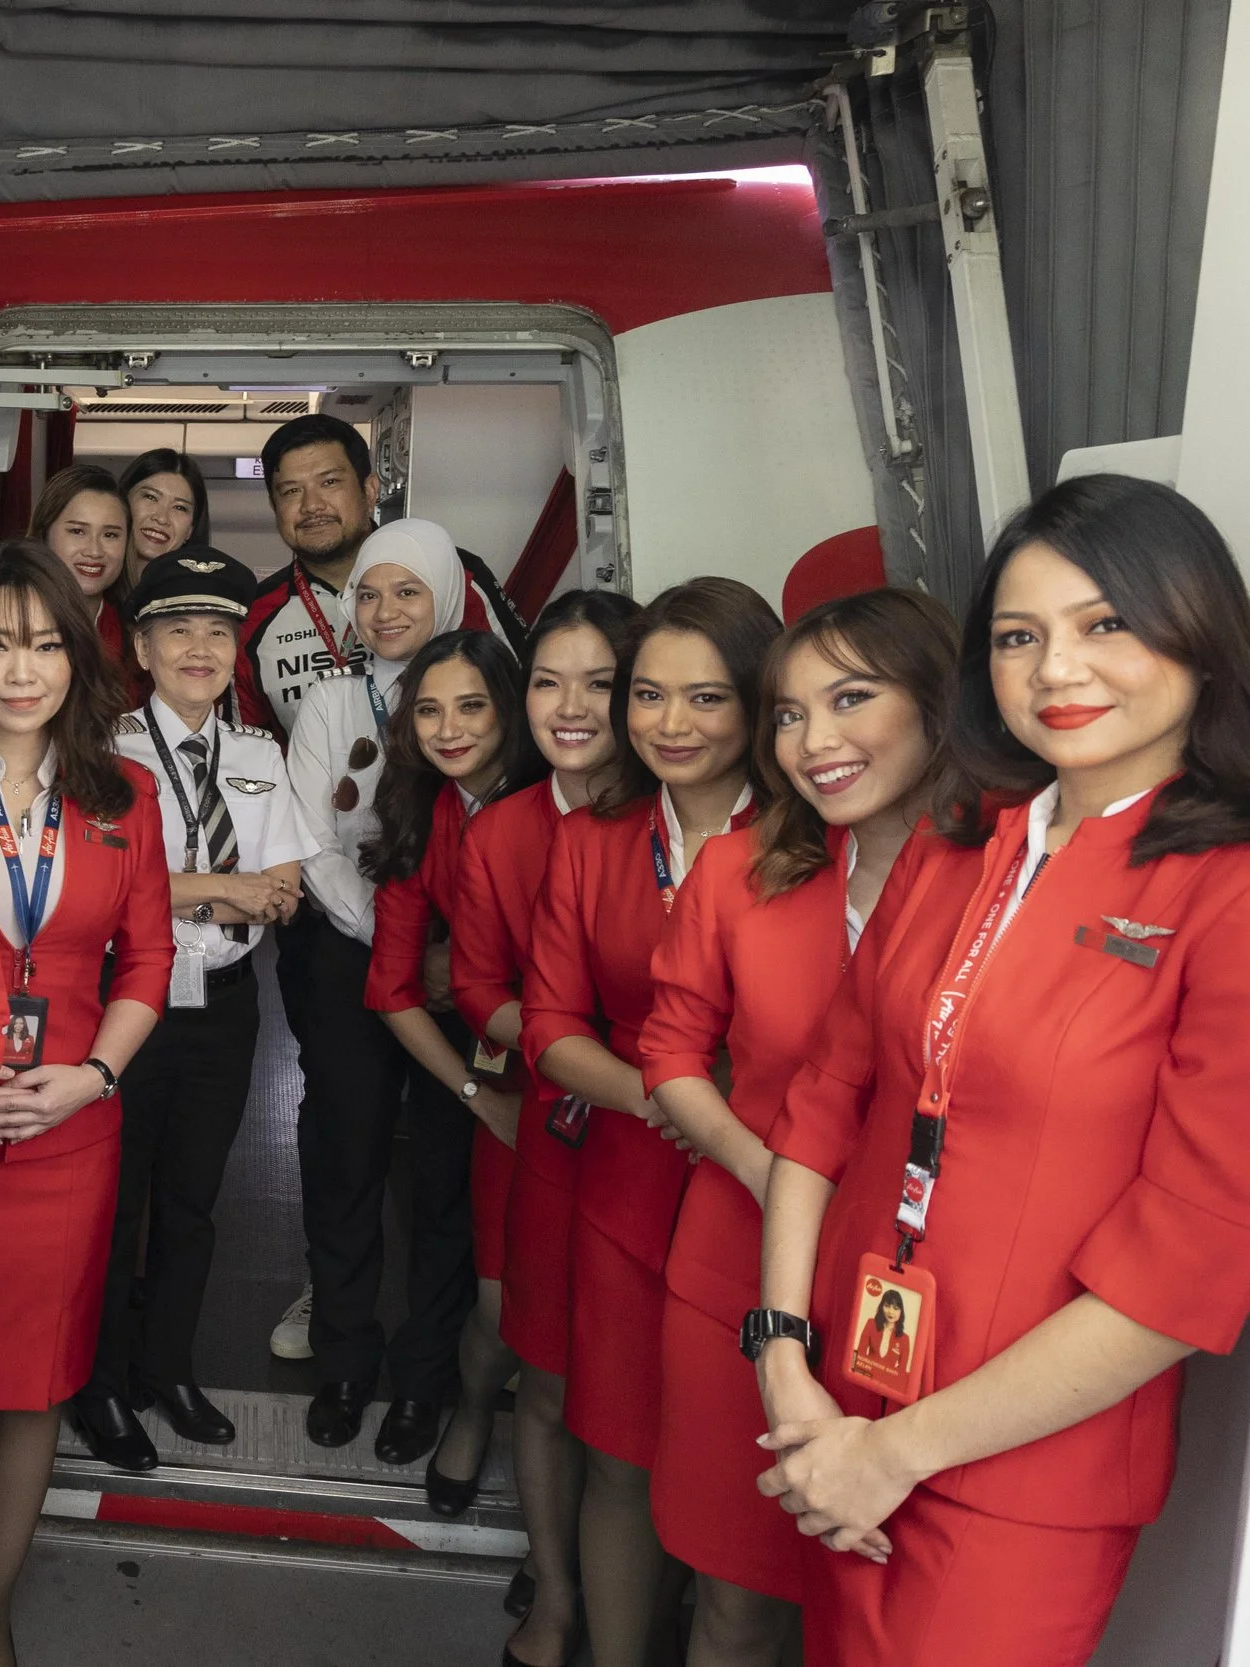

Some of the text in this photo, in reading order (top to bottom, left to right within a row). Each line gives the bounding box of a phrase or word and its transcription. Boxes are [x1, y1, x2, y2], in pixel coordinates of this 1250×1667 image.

[276, 625, 336, 645] TOSHIA
[1003, 861, 1019, 887] ONE
[954, 903, 1000, 983] ONE FOR ALL
